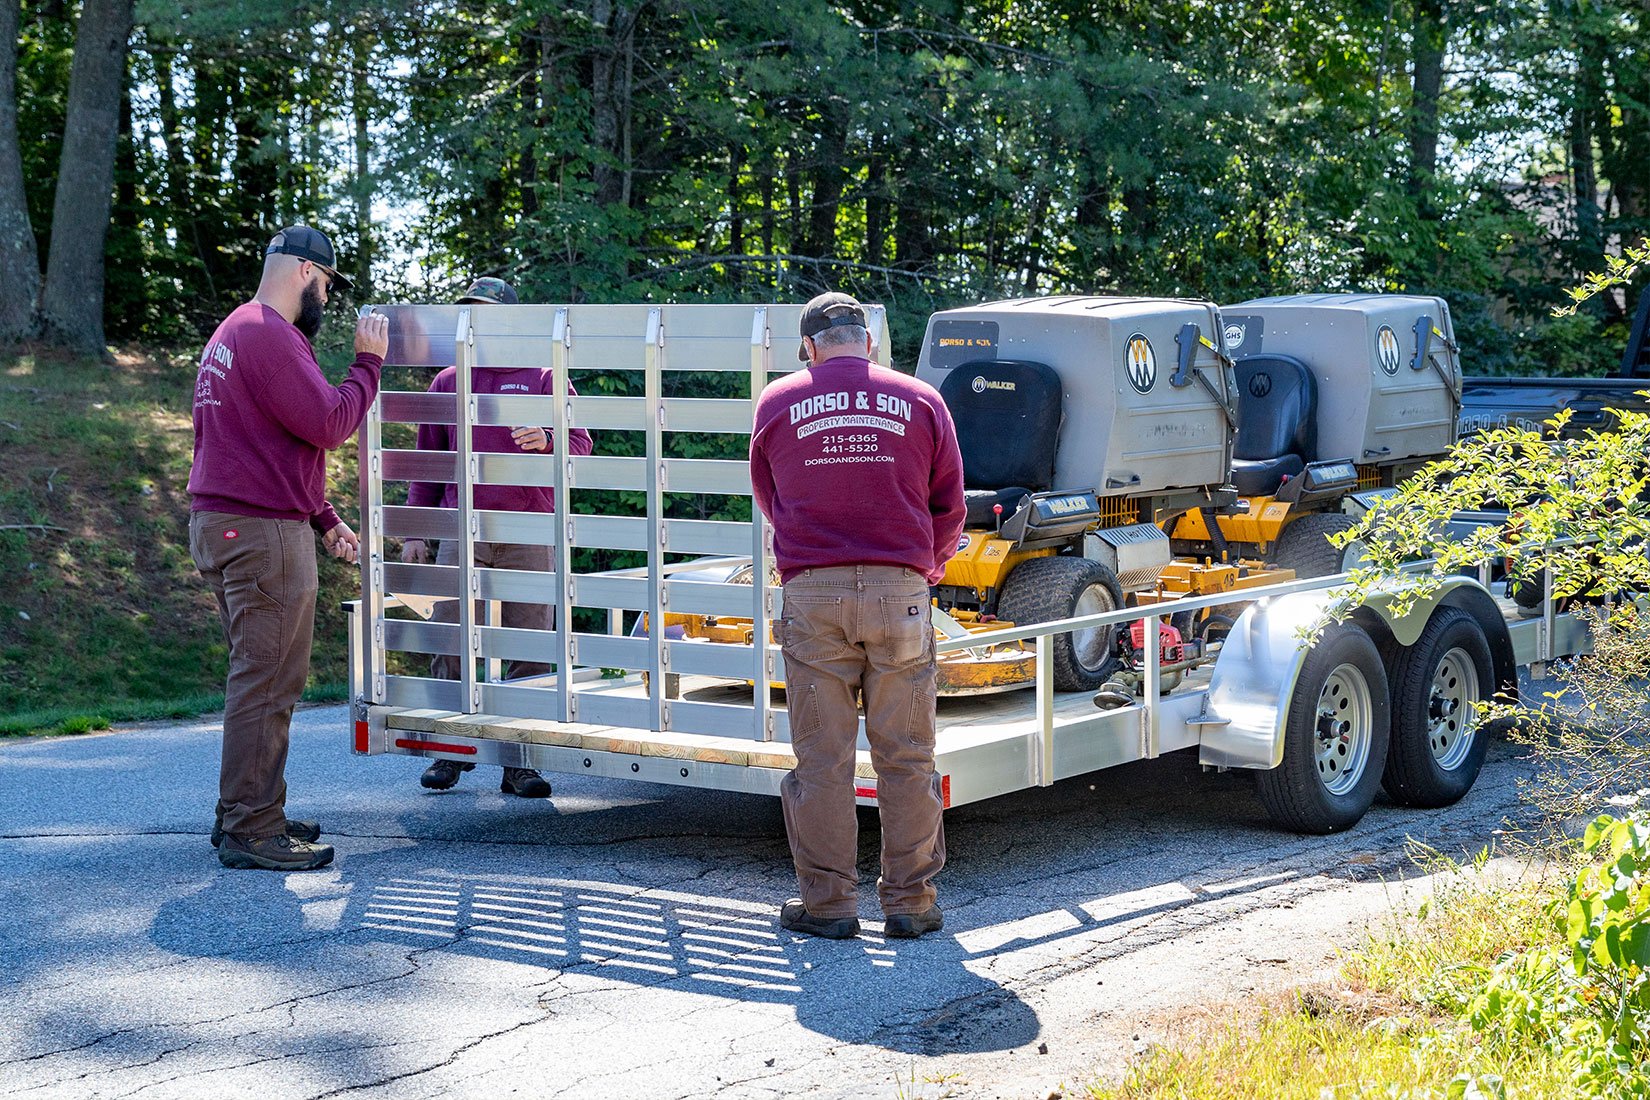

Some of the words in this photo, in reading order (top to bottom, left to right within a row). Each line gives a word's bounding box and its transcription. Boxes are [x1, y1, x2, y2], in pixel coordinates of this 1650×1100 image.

[1225, 332, 1241, 340] GHS
[986, 380, 1016, 391] WALKER
[789, 391, 849, 425] DORSO
[855, 391, 870, 410] &
[876, 393, 912, 422] SON
[798, 417, 840, 437] PROPERTY
[842, 415, 904, 434] MAINTENANCE
[1456, 414, 1491, 435] RSO
[822, 434, 878, 444] 215-6365
[822, 444, 878, 453] 441-5520
[805, 455, 895, 466] DORSOANDSON.COM
[1047, 496, 1089, 515] WALKER
[1126, 529, 1144, 539] HOT
